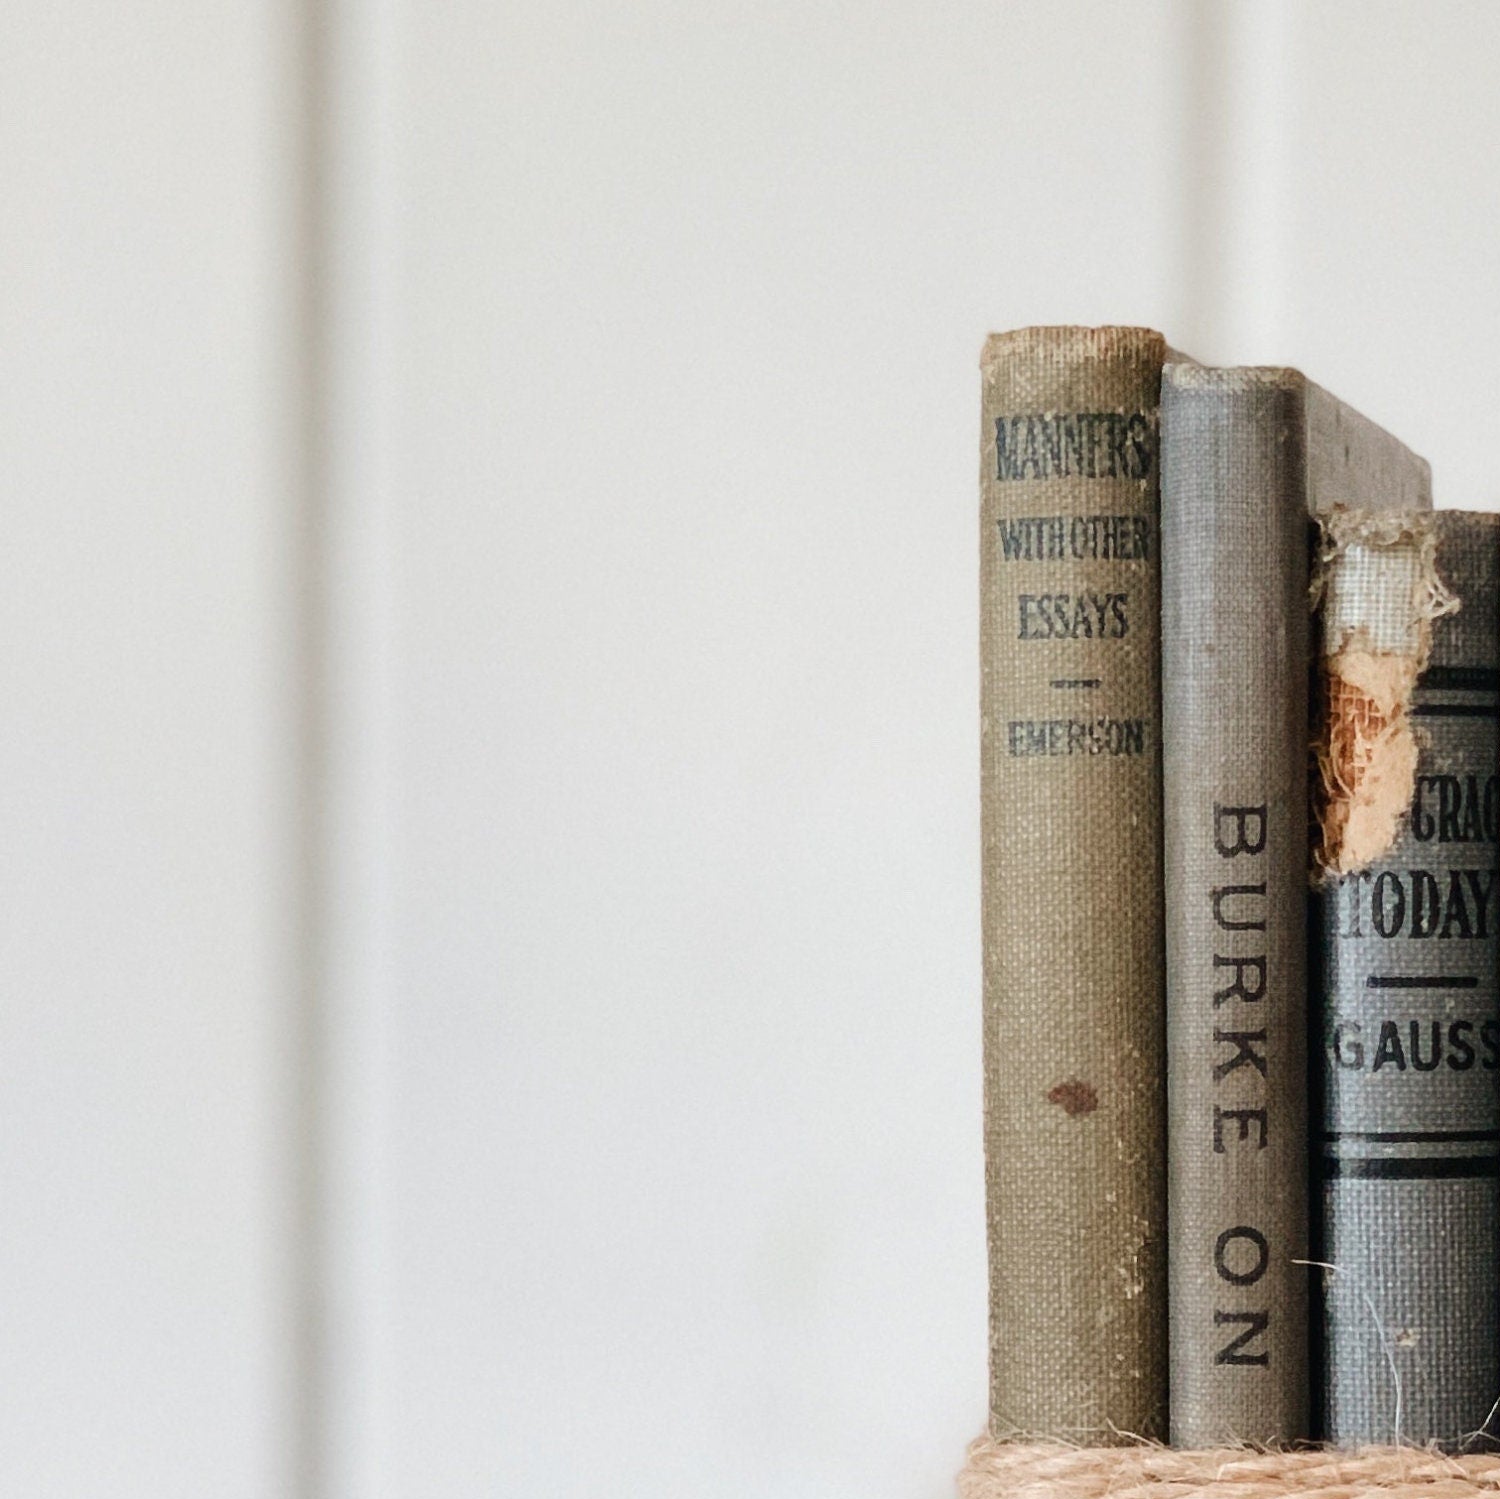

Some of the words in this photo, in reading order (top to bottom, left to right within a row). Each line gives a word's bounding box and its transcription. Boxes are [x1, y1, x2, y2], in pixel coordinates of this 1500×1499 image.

[997, 516, 1065, 562] WITH
[1071, 515, 1149, 562] OTHER
[1017, 593, 1129, 640] ESSAYS
[1008, 719, 1144, 757] EMERSON
[1338, 870, 1500, 939] TODAY
[1208, 802, 1269, 1155] BURKE
[1334, 1019, 1500, 1073] GAUSS
[1213, 1224, 1270, 1367] ON
